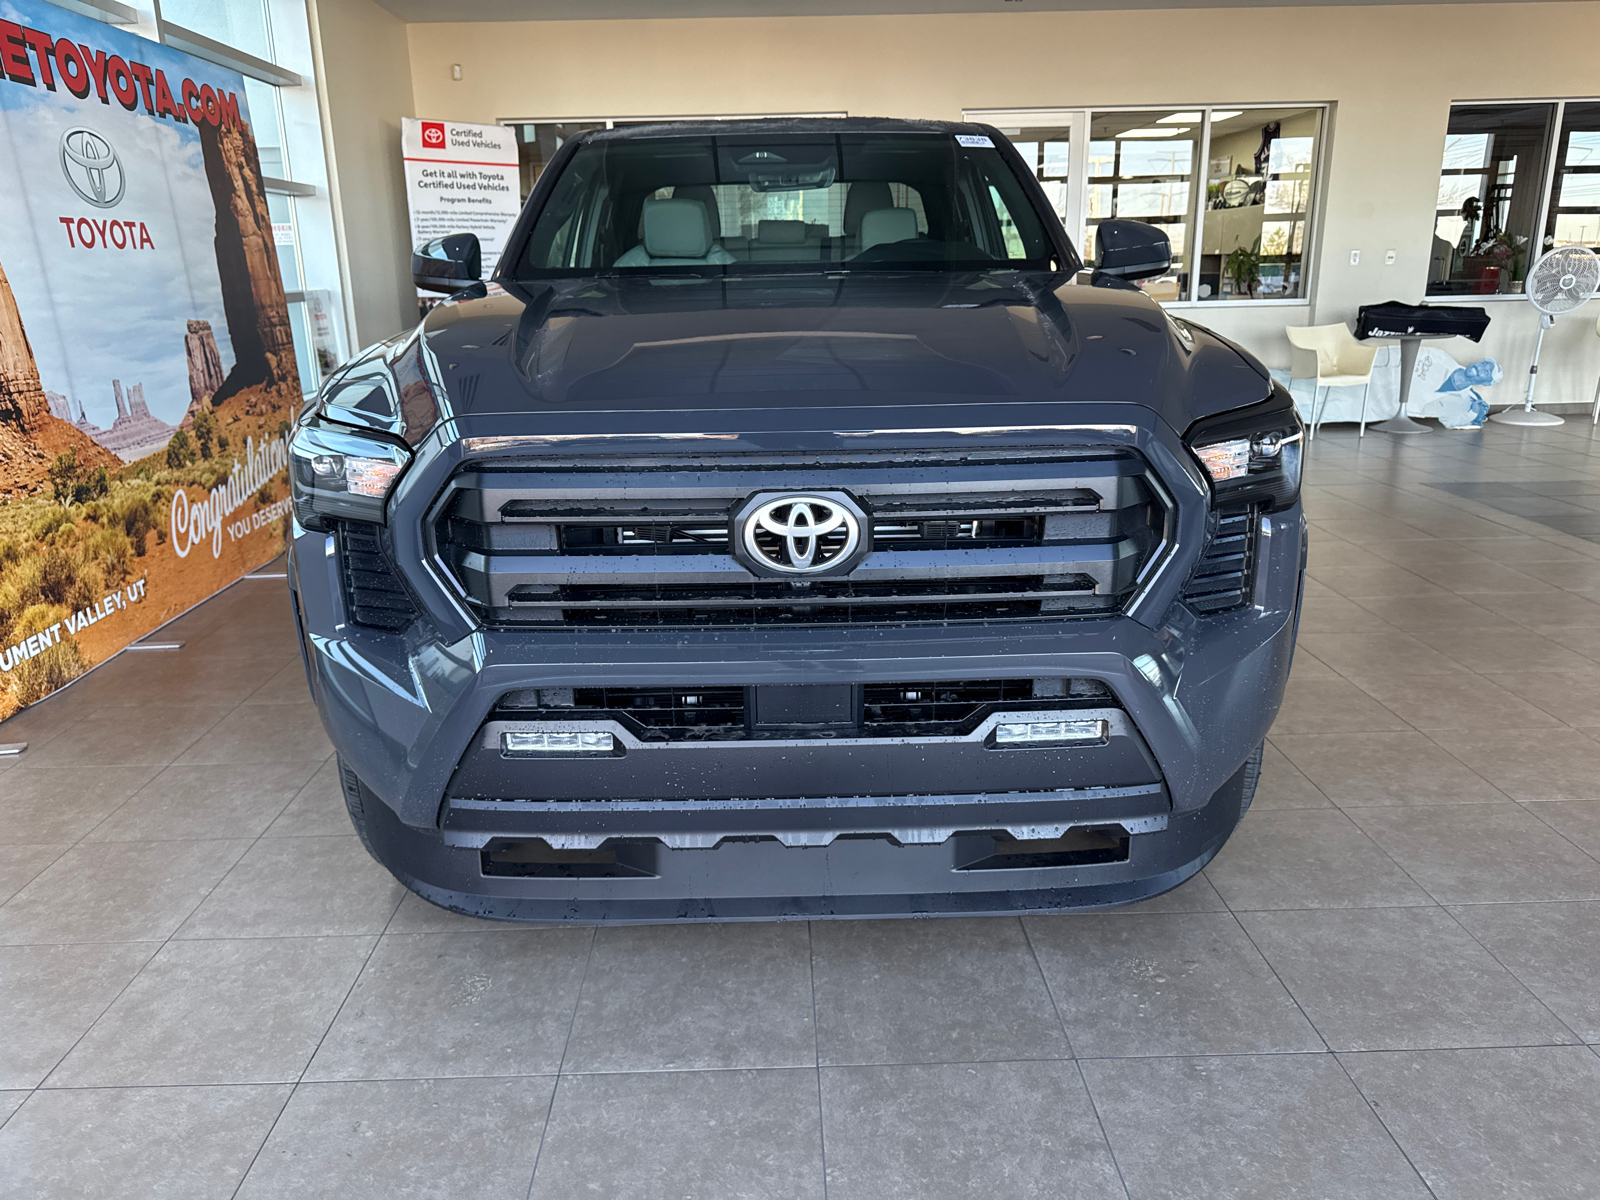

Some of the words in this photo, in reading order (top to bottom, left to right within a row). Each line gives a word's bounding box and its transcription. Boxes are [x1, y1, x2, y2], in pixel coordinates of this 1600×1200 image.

[0, 17, 242, 132] ETOYOTA.COM
[450, 128, 483, 138] Certified
[451, 138, 470, 147] Used
[471, 139, 502, 150] Vehicles
[422, 169, 438, 178] Get
[439, 169, 446, 178] it
[447, 170, 458, 179] all
[459, 170, 477, 180] with
[478, 172, 504, 182] Toyota
[418, 180, 454, 189] Certified
[456, 181, 476, 191] Used
[477, 183, 509, 192] Vehicles
[440, 196, 467, 205] Program
[468, 197, 492, 205] Benefits
[59, 216, 155, 251] TOYOTA
[226, 516, 251, 542] YOU
[63, 590, 127, 636] VALLEY,
[126, 578, 146, 602] UT
